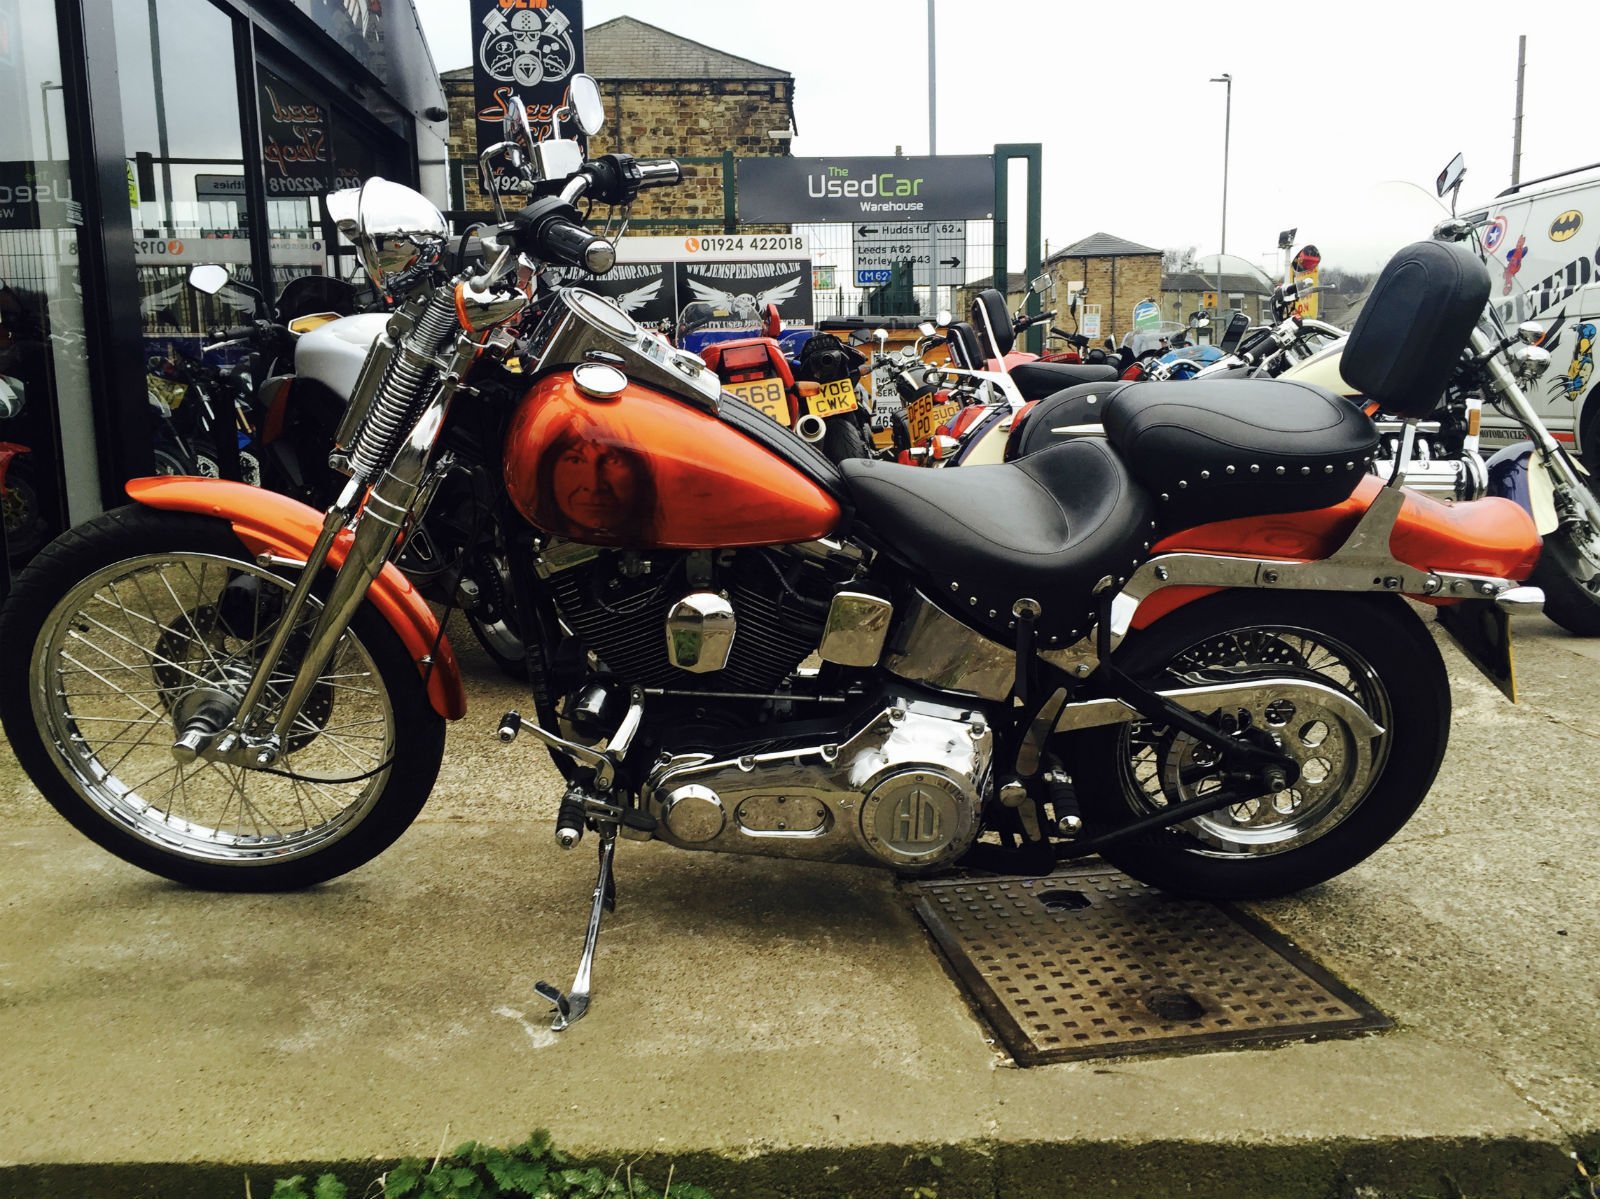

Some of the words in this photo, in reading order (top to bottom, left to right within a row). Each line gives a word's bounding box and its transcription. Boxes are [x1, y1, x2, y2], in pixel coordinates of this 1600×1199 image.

[828, 166, 849, 177] The
[860, 202, 924, 211] Warehouse
[701, 239, 744, 251] 01924
[750, 237, 803, 250] 422018
[858, 246, 887, 255] Leeds
[858, 256, 892, 266] Morley
[686, 262, 801, 279] WWW.JEMSPEEDSHOP.CO.UK
[819, 380, 851, 398] Y06
[815, 396, 850, 413] CWK
